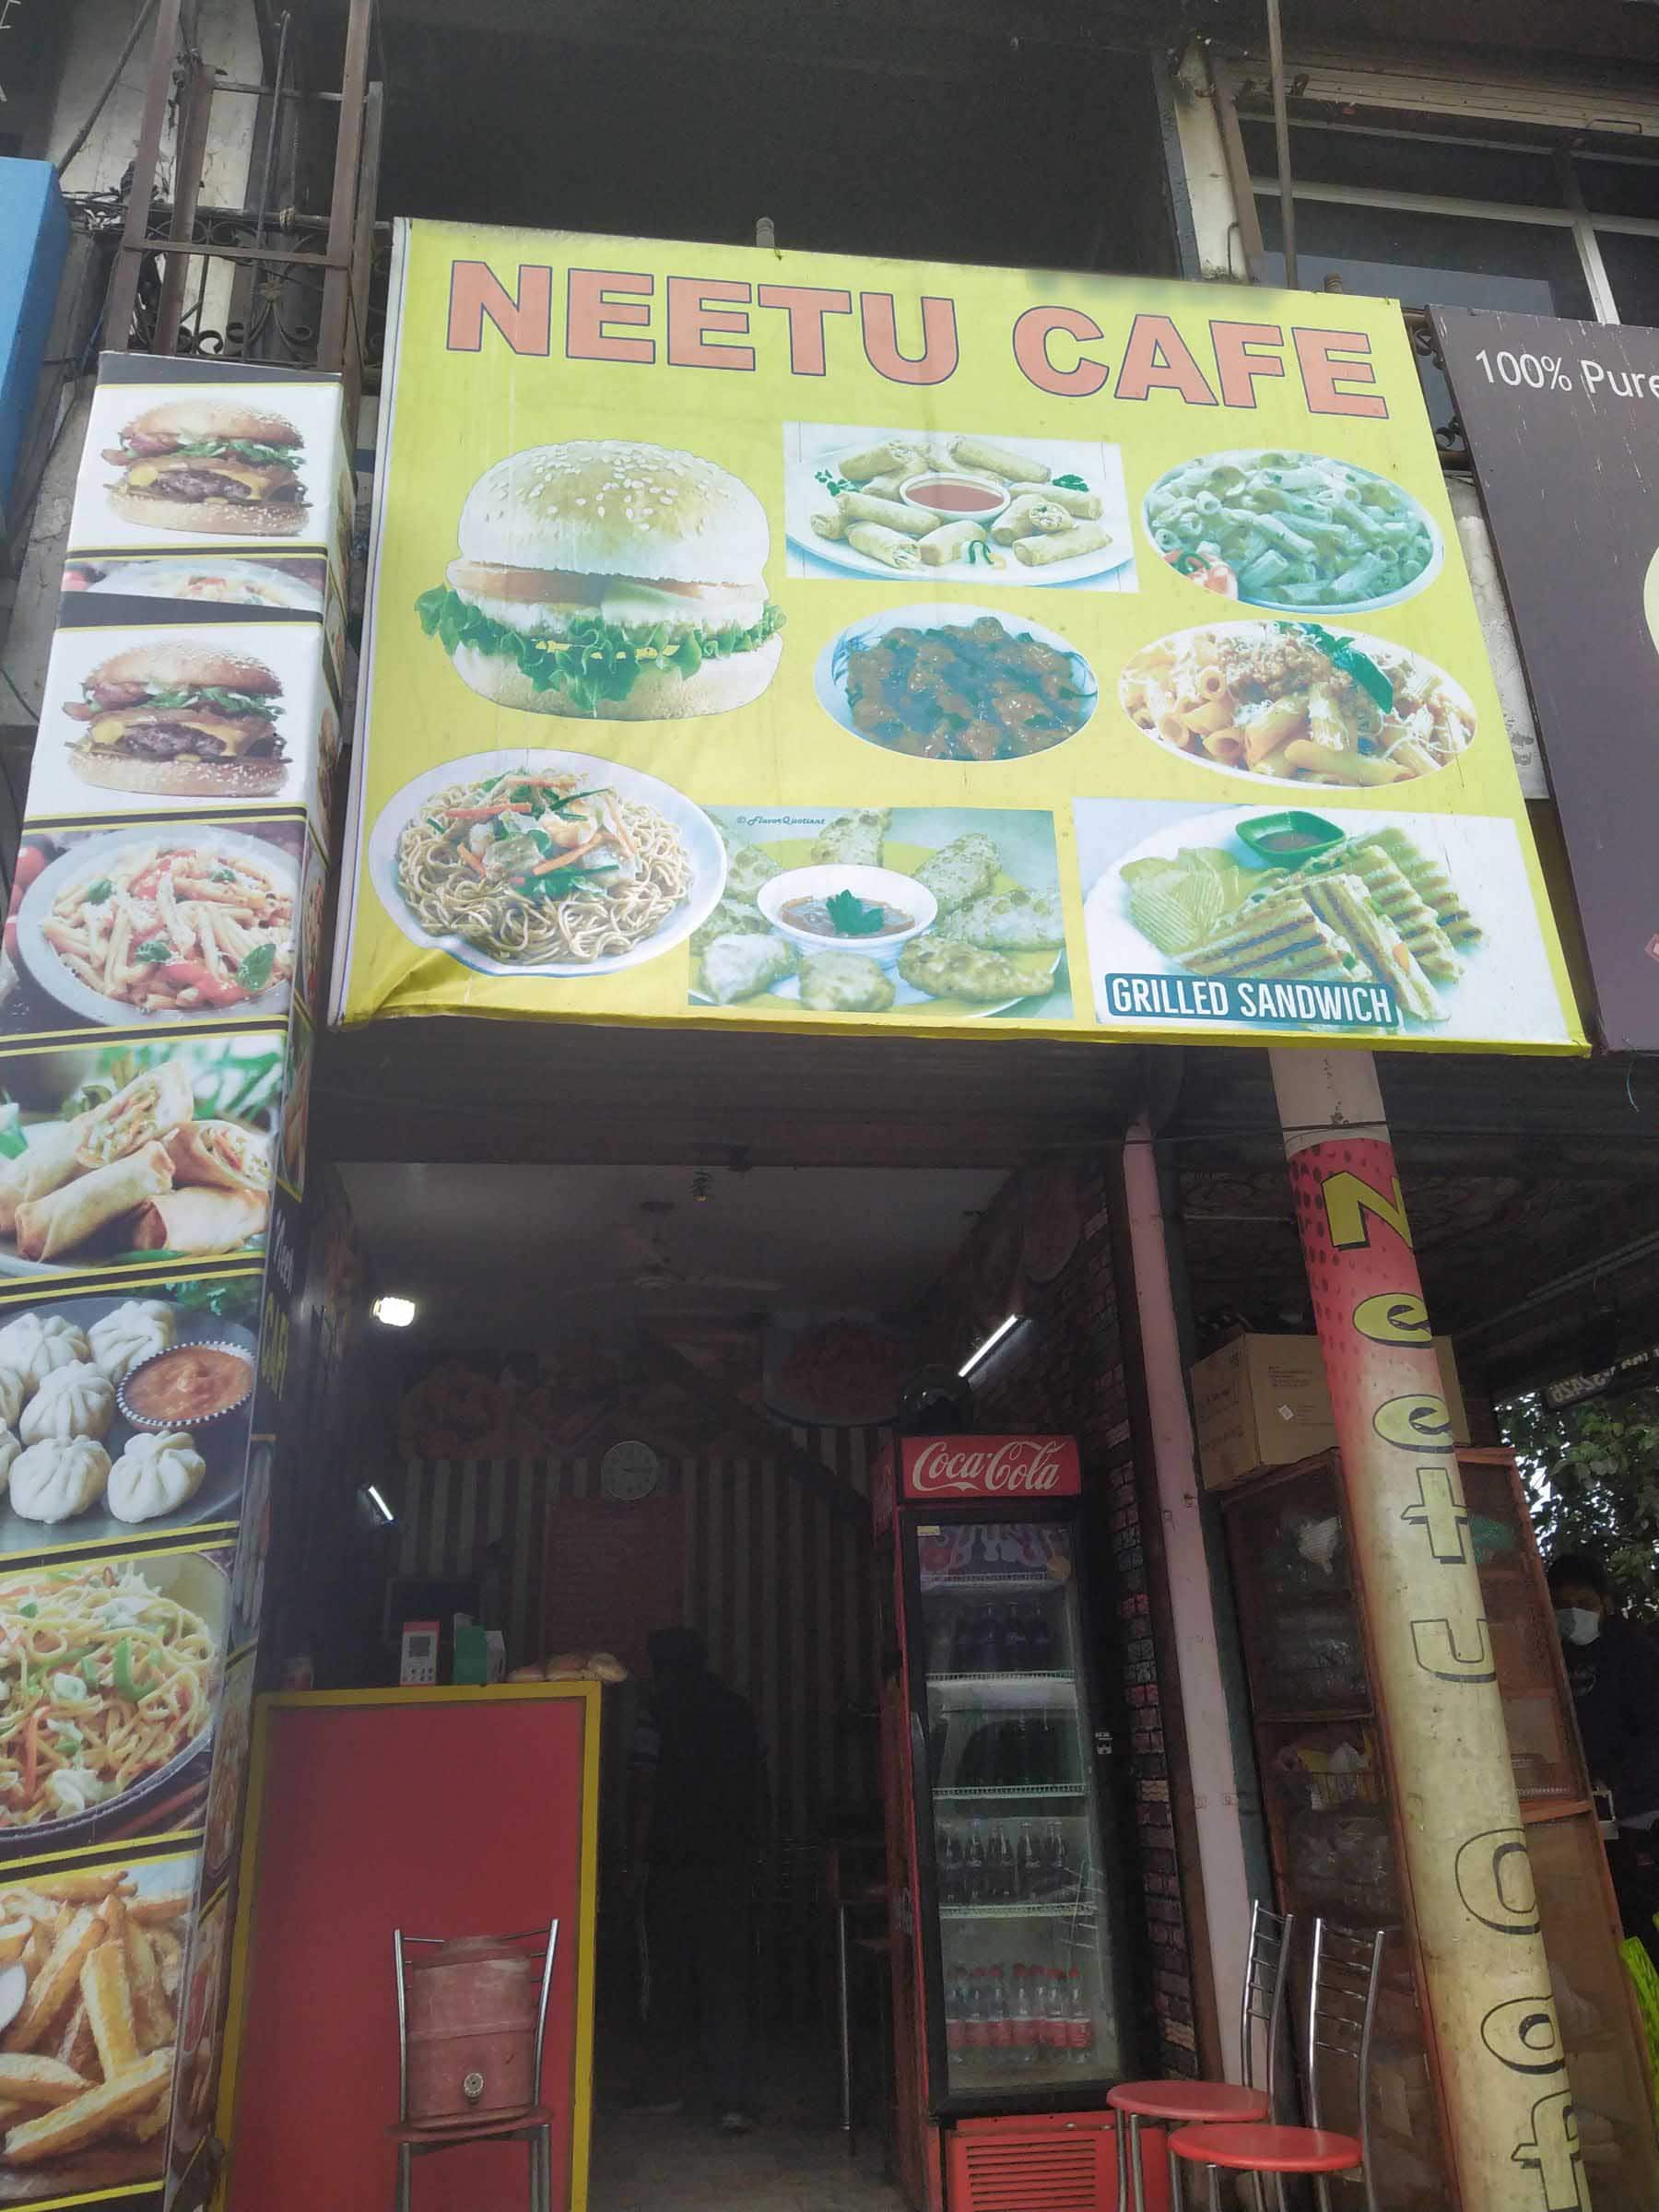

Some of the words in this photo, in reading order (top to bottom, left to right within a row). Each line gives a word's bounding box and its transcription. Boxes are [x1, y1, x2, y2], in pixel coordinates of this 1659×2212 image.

[446, 260, 959, 385] NEETU
[1012, 305, 1389, 418] CAFE
[1476, 349, 1572, 392] 100%
[1112, 977, 1230, 1016] GRILLED
[1237, 982, 1393, 1024] SANDWICH
[912, 1441, 1065, 1491] Coca-Cola
